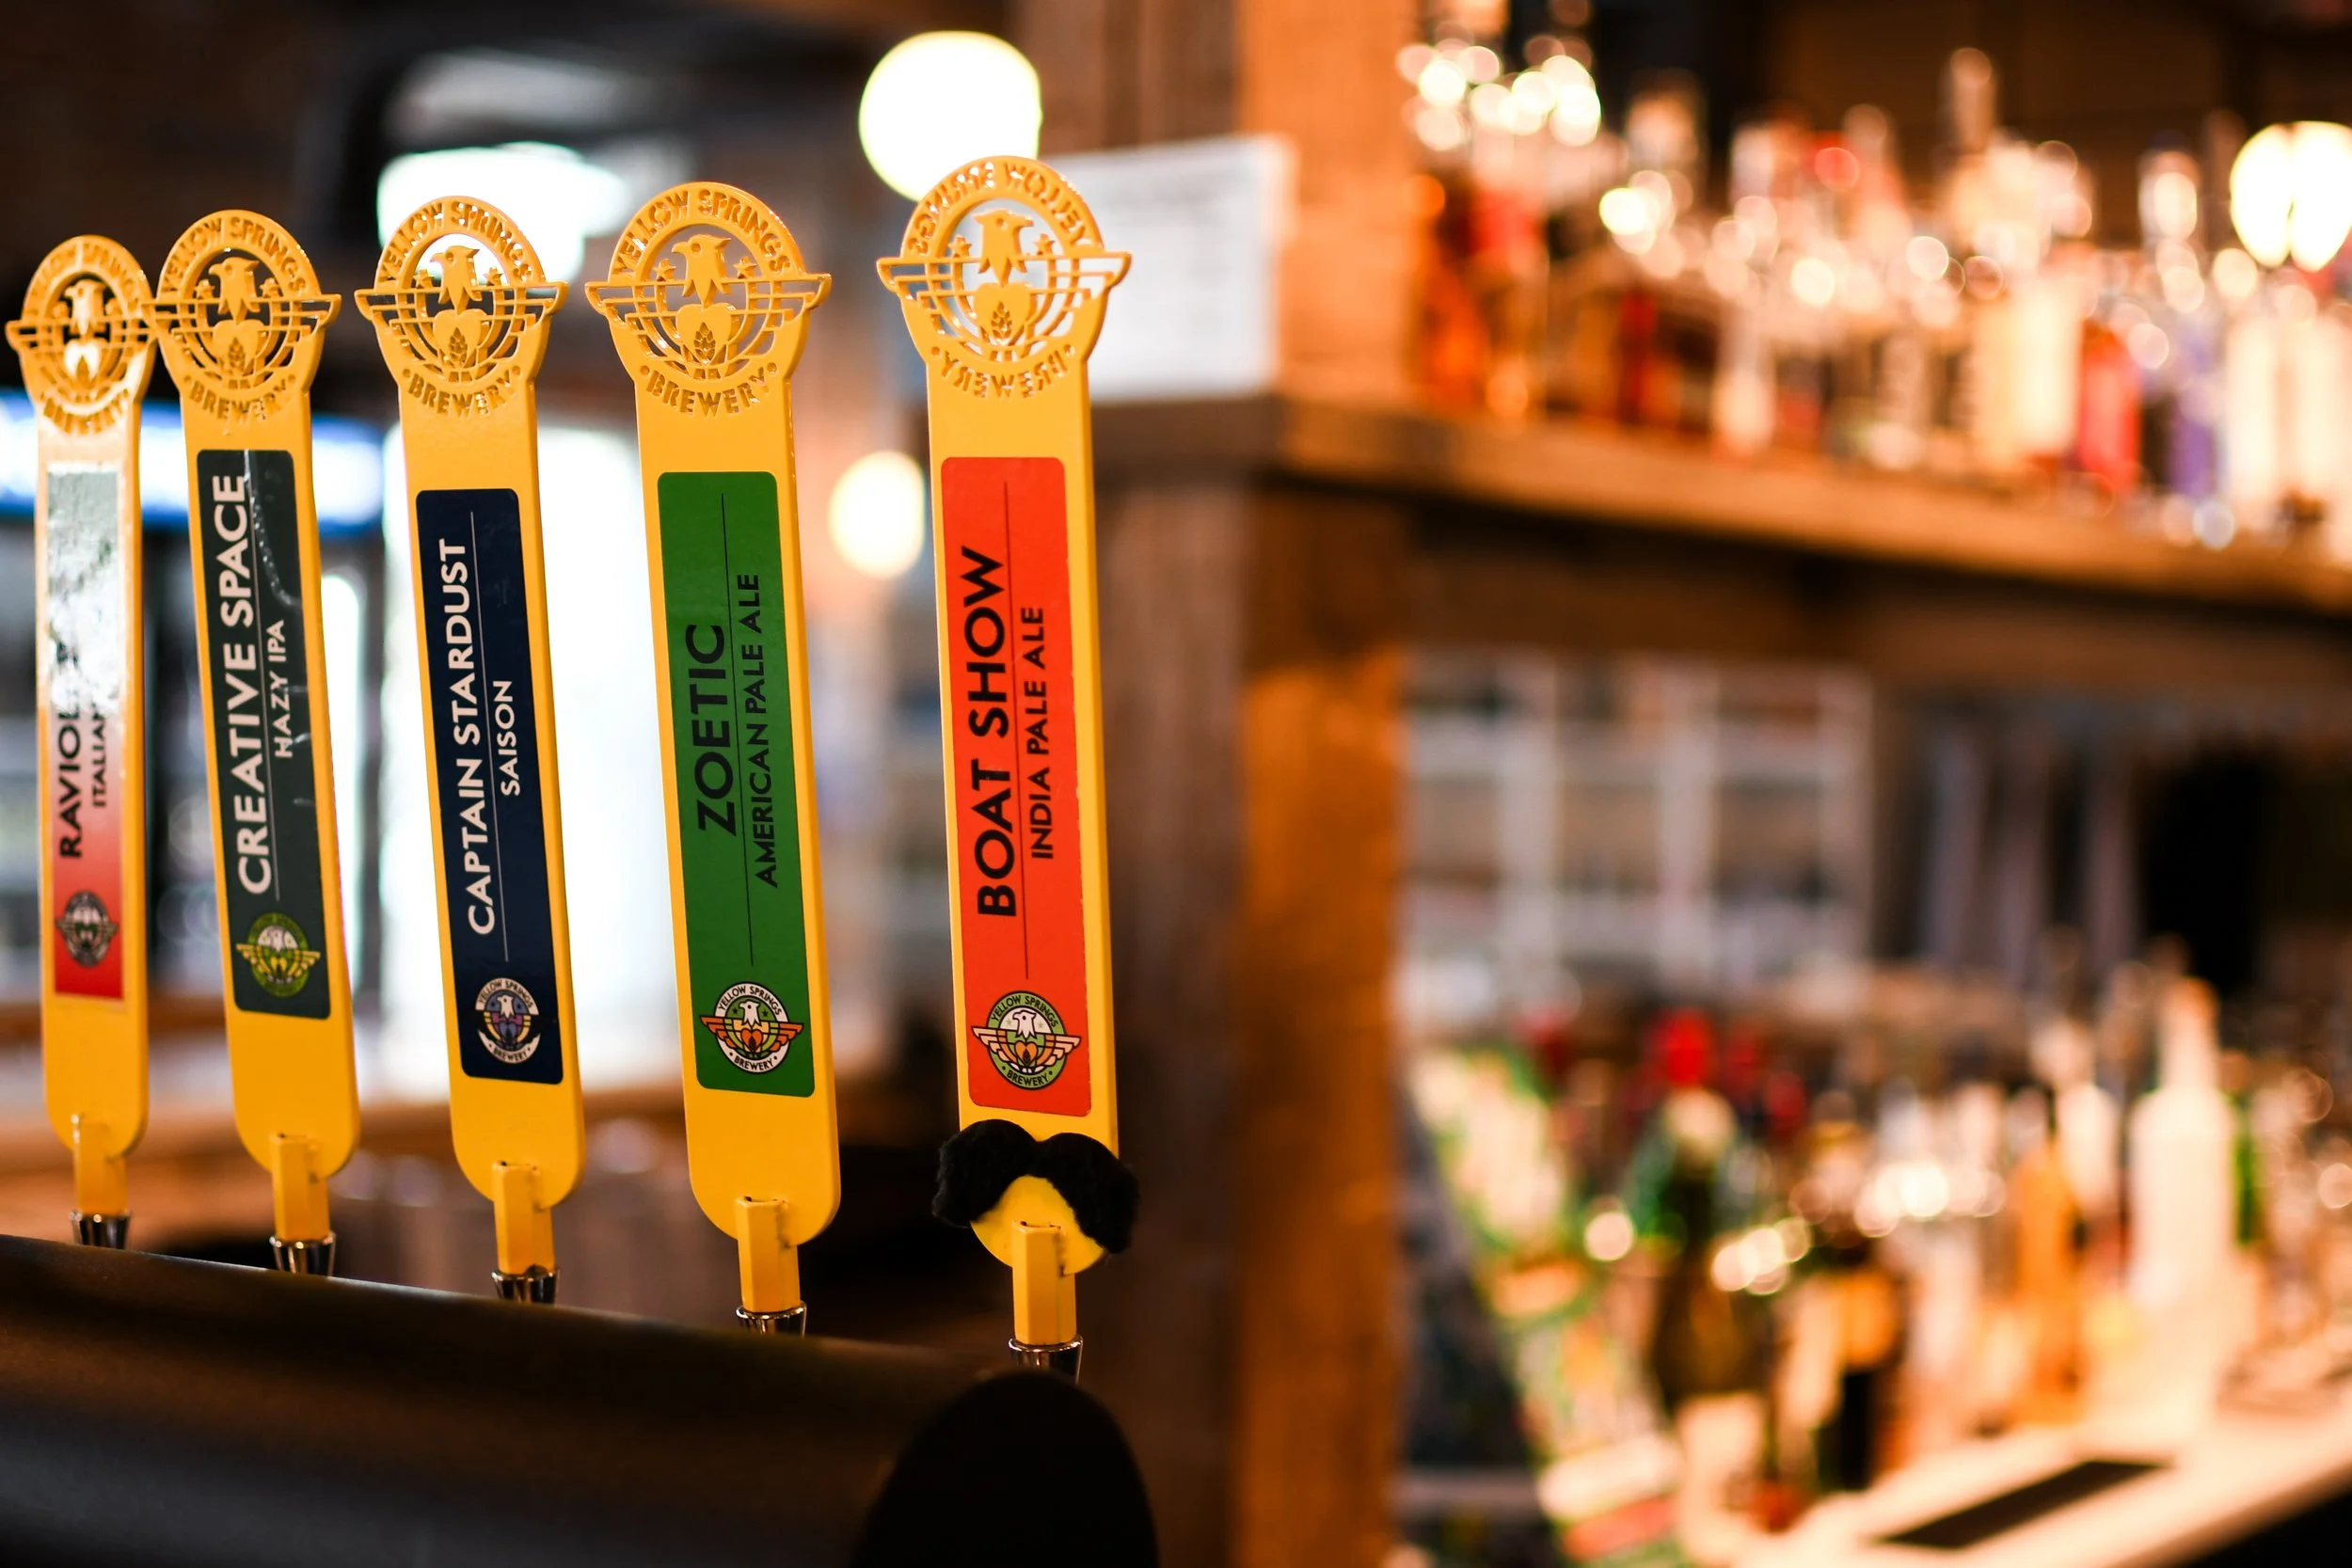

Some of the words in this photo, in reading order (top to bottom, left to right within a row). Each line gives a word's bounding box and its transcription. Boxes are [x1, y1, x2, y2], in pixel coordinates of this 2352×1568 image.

[230, 216, 307, 292] SPRINGS
[378, 201, 442, 282] YELLOW
[451, 200, 533, 280] SPRINGS
[613, 190, 689, 274] YELLOW
[697, 188, 791, 274] SPRINGS
[408, 370, 516, 417] BREWERY
[645, 366, 770, 417] BREWERY
[213, 475, 254, 629] SPACE
[266, 620, 287, 662] IPA
[438, 538, 481, 745] STARDUST
[738, 574, 762, 634] ALE
[960, 546, 1009, 738] SHOW
[1021, 606, 1046, 670] ALE
[269, 670, 293, 758] HAZY
[741, 643, 766, 715] PALE
[1024, 680, 1050, 755] PALE
[226, 642, 272, 895] CREATIVE
[492, 679, 520, 797] SAISON
[685, 624, 737, 837] ZOETIC
[456, 757, 495, 935] CAPTAIN
[746, 723, 778, 888] AMERICAN
[972, 757, 1017, 917] BOAT
[1027, 767, 1055, 860] INDIA
[718, 985, 747, 1011] YELLOW
[749, 985, 783, 1016] SPRINGS
[991, 994, 1022, 1022] YELLOW
[1025, 995, 1059, 1027] SPRINGS
[734, 1054, 773, 1071] BREWERY
[1006, 1069, 1049, 1086] BREWERY
